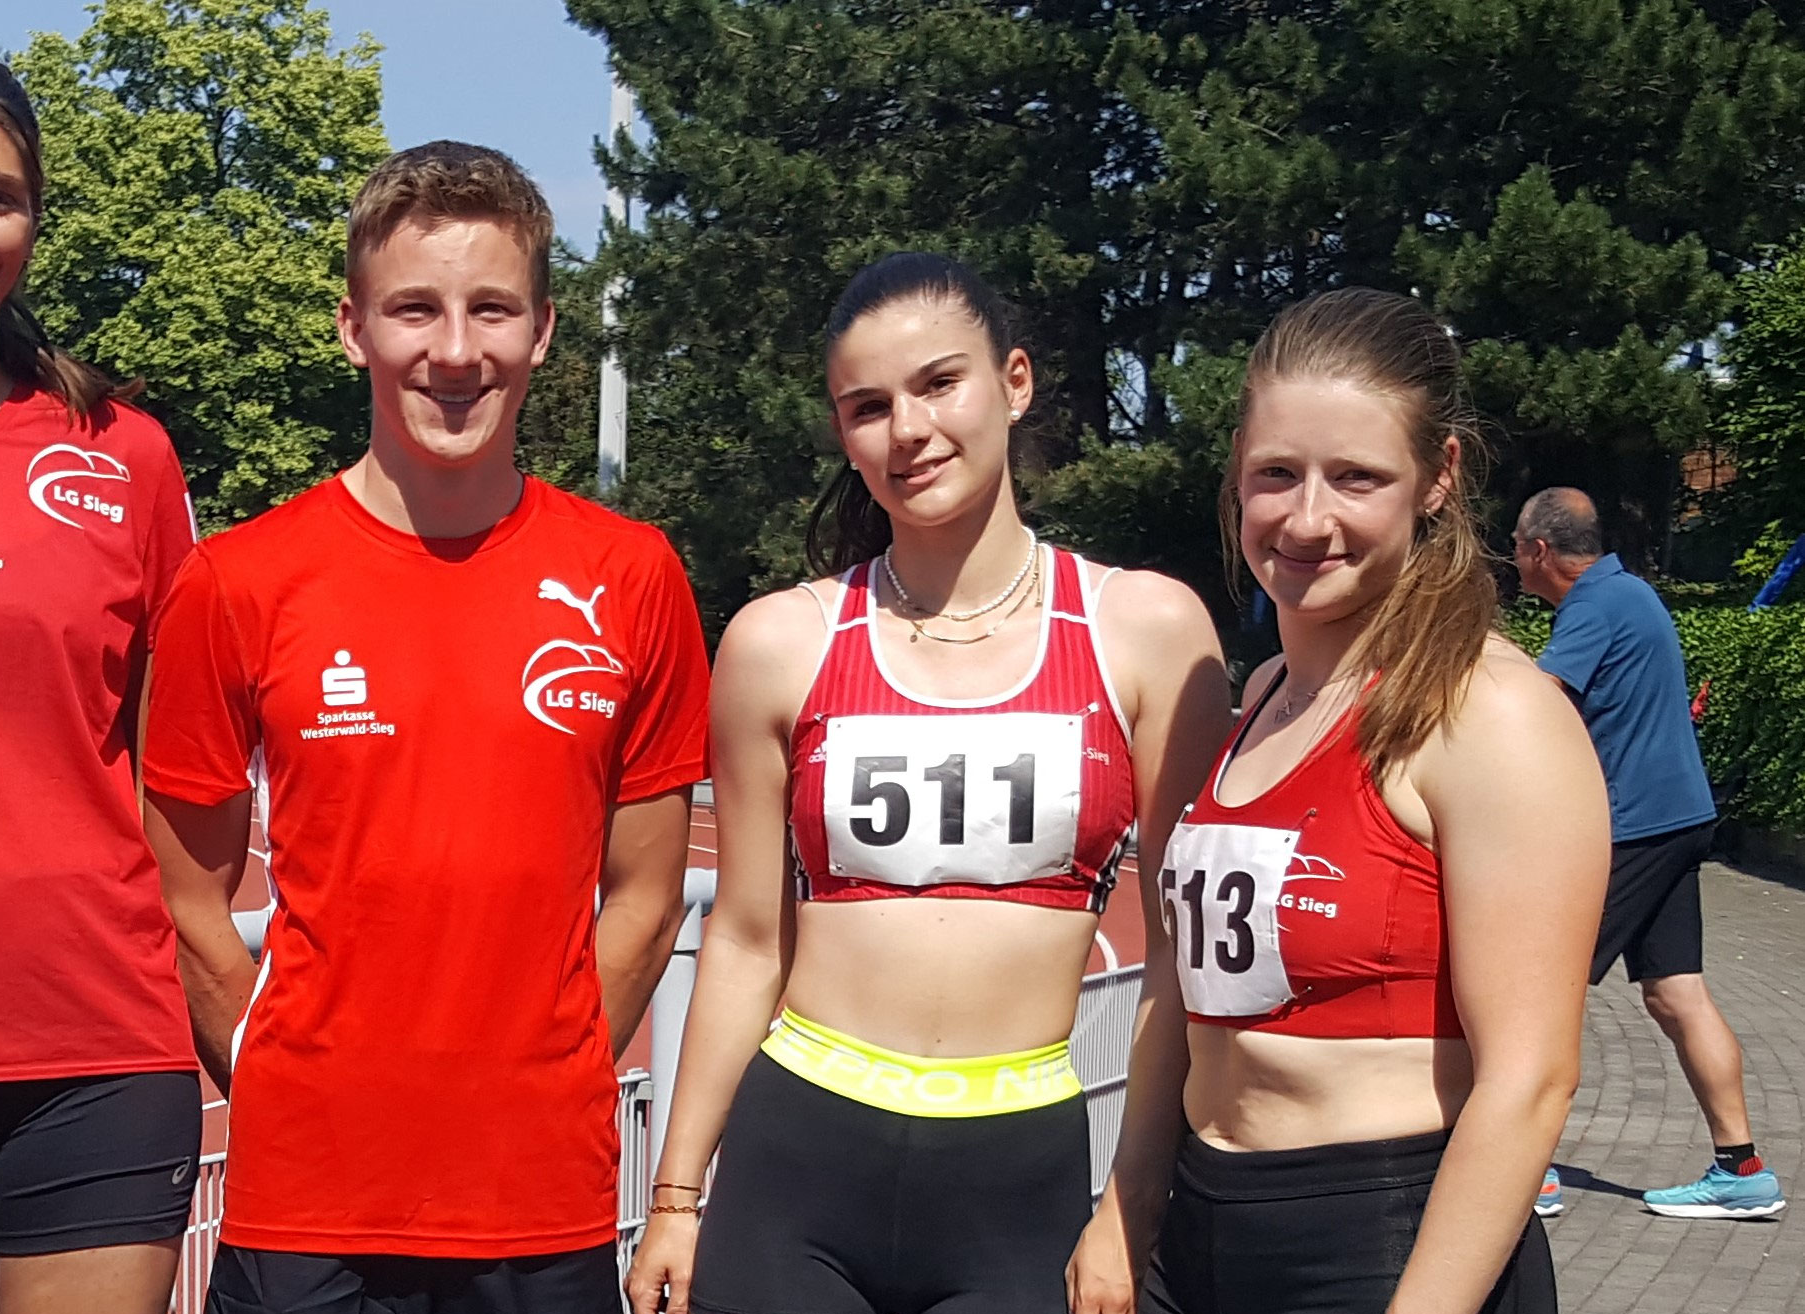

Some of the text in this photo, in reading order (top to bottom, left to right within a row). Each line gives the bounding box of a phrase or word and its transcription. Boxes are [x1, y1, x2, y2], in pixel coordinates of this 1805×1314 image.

[54, 485, 124, 523] LG Sieg
[317, 710, 376, 725] Sparkasse
[546, 690, 615, 718] LG Sieg
[300, 723, 395, 740] Westerwald-Sieg
[849, 753, 1035, 846] 511
[1276, 893, 1337, 918] G Sieg
[819, 1046, 967, 1103] PRO
